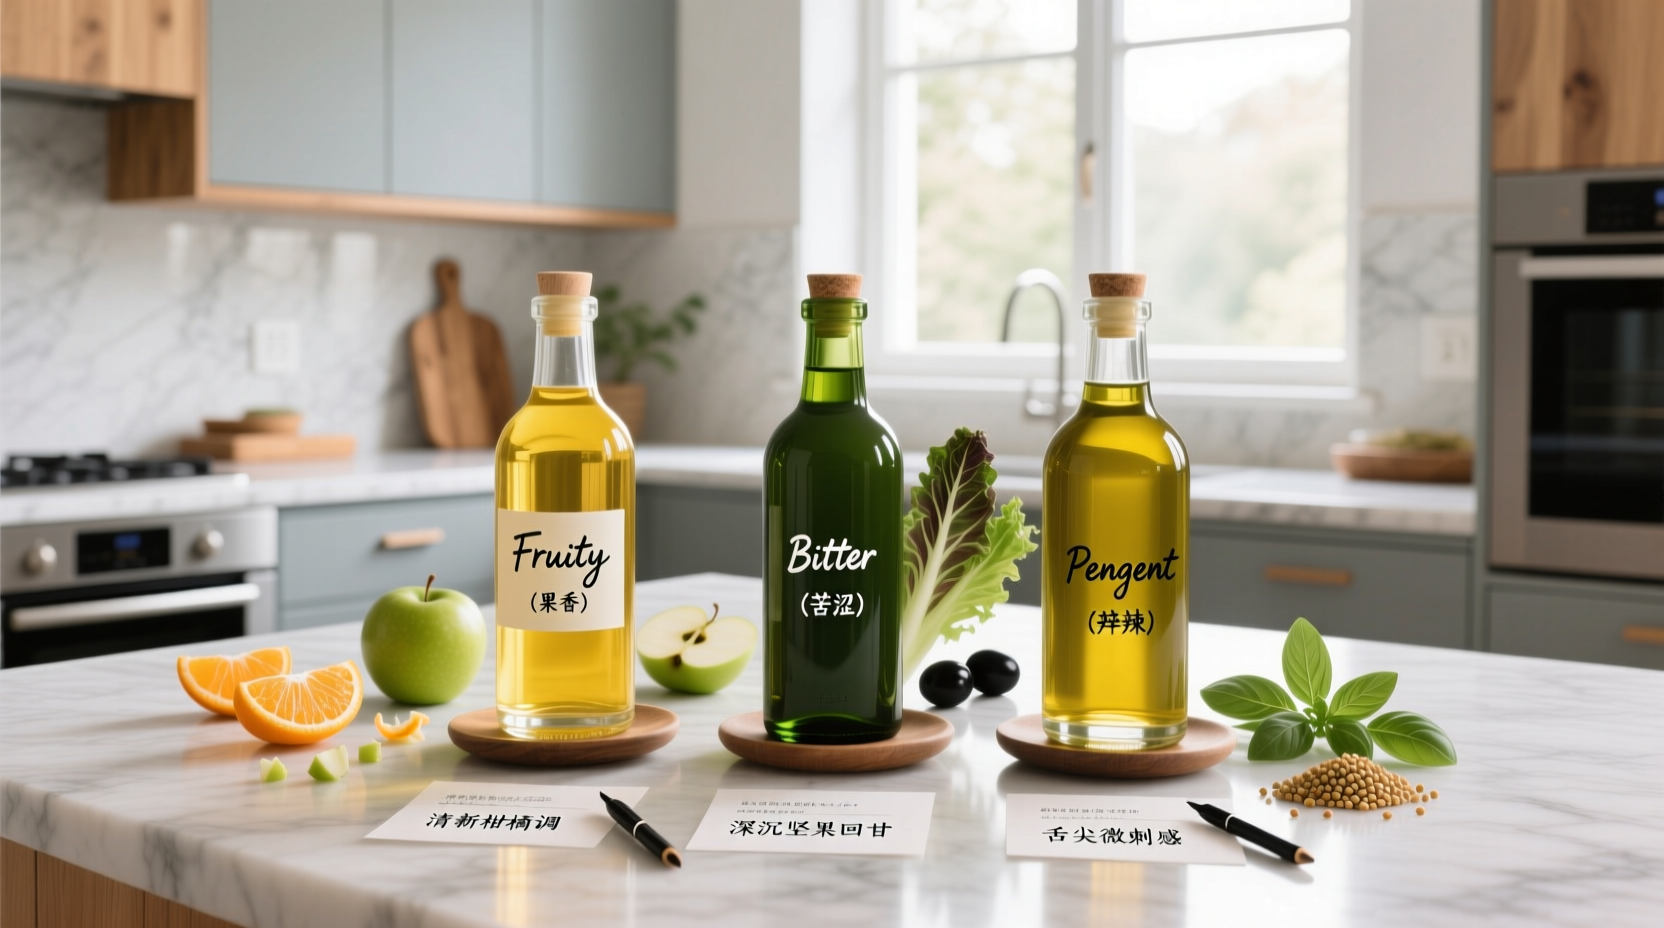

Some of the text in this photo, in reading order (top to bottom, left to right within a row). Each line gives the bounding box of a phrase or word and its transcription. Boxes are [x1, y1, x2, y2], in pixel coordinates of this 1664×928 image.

[512, 530, 611, 589] Fruity
[787, 533, 878, 574] Bitter
[1066, 545, 1180, 600] Pengent
[729, 819, 893, 838] 深沉坚果回甘
[1041, 826, 1182, 846] 舌尖微刺感
